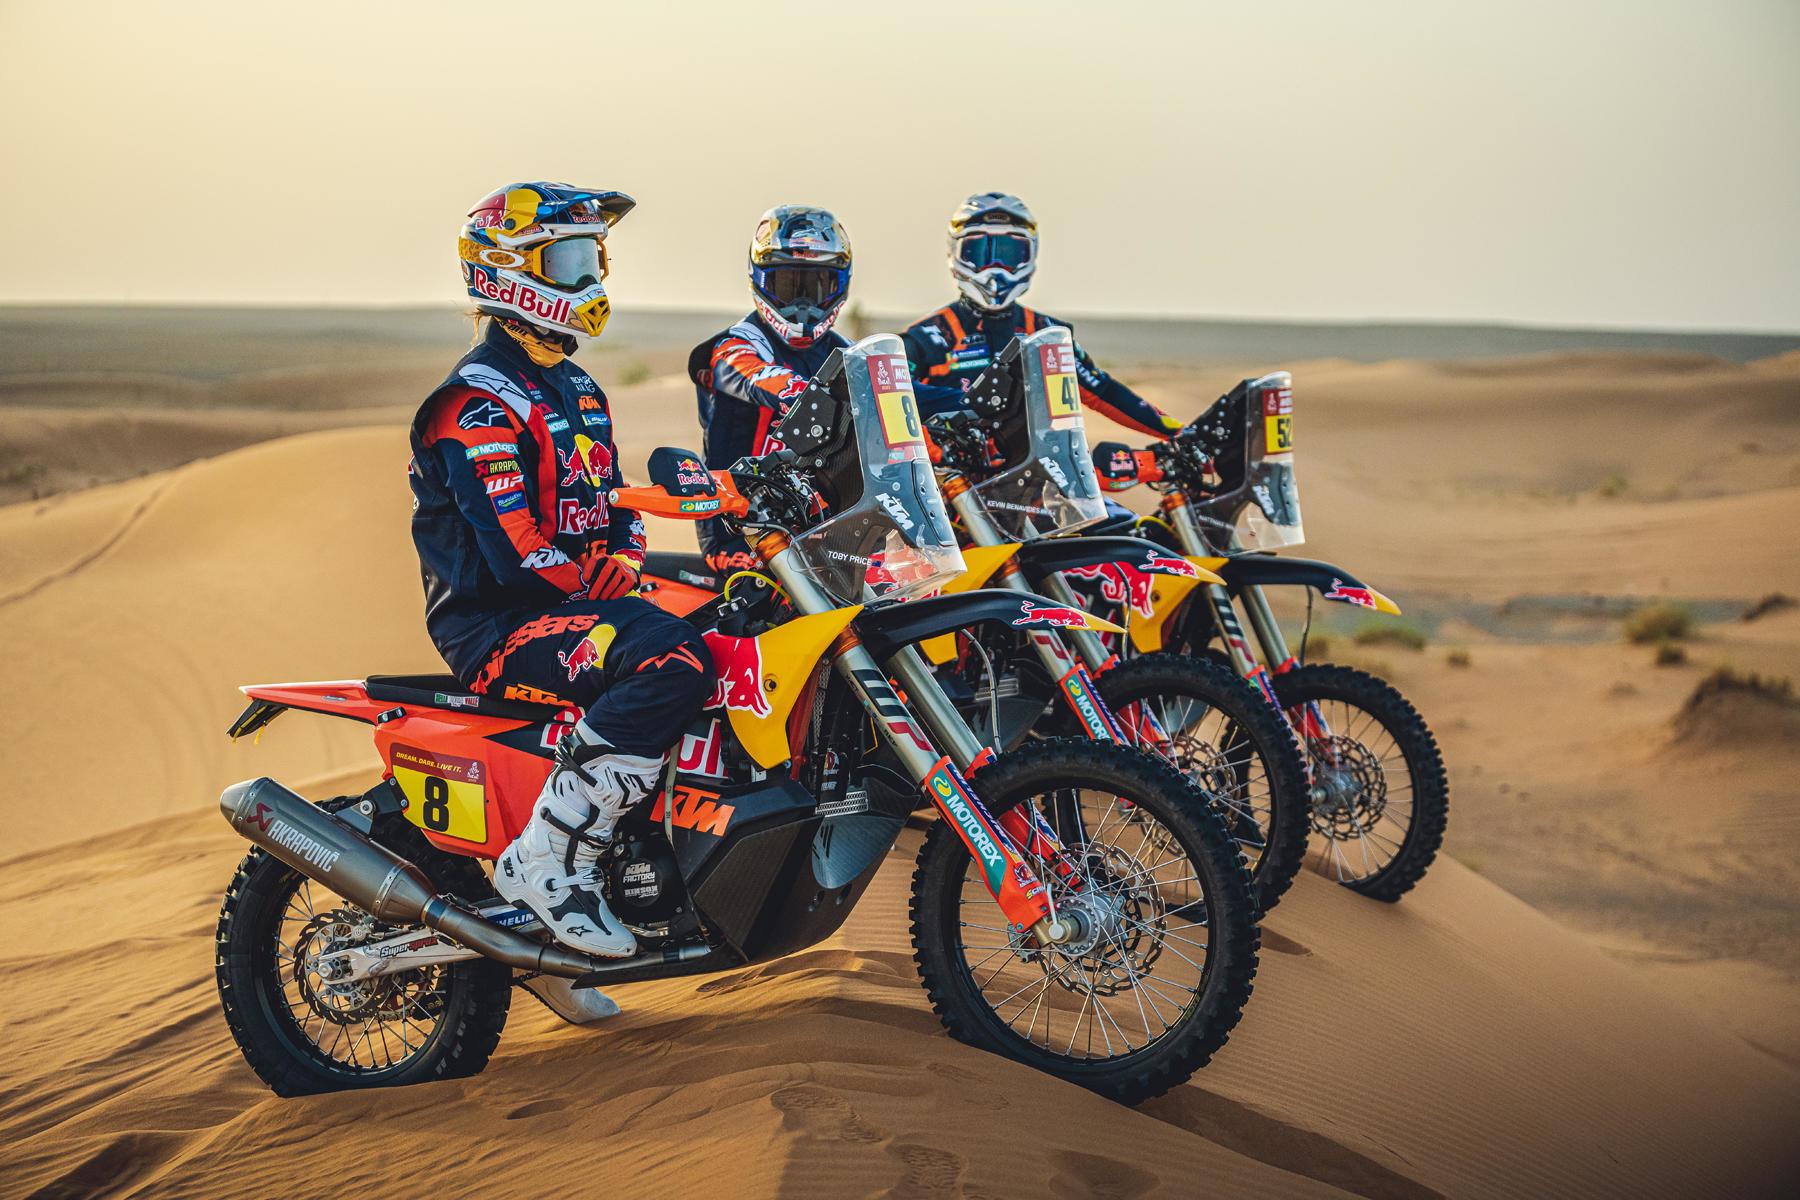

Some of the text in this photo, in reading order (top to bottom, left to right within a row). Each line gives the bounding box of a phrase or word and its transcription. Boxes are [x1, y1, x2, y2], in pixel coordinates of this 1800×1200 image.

[475, 266, 571, 325] Red Bull
[578, 396, 601, 410] KTM
[902, 395, 920, 438] 8
[1039, 457, 1069, 488] KTM
[558, 488, 602, 535] Red
[875, 493, 914, 530] KTM
[986, 500, 1040, 514] KEVIN BENAVIDES
[520, 545, 571, 569] KTM
[827, 551, 873, 567] TOBY PRICE
[396, 751, 462, 773] DREAM. DARE. LIVE IT.
[423, 775, 449, 832] 8
[650, 784, 736, 837] KTM
[267, 820, 340, 873] AKRAPOVIČ
[946, 793, 1002, 867] MOTOREX
[623, 872, 656, 883] FACTORY
[625, 863, 651, 875] KTM
